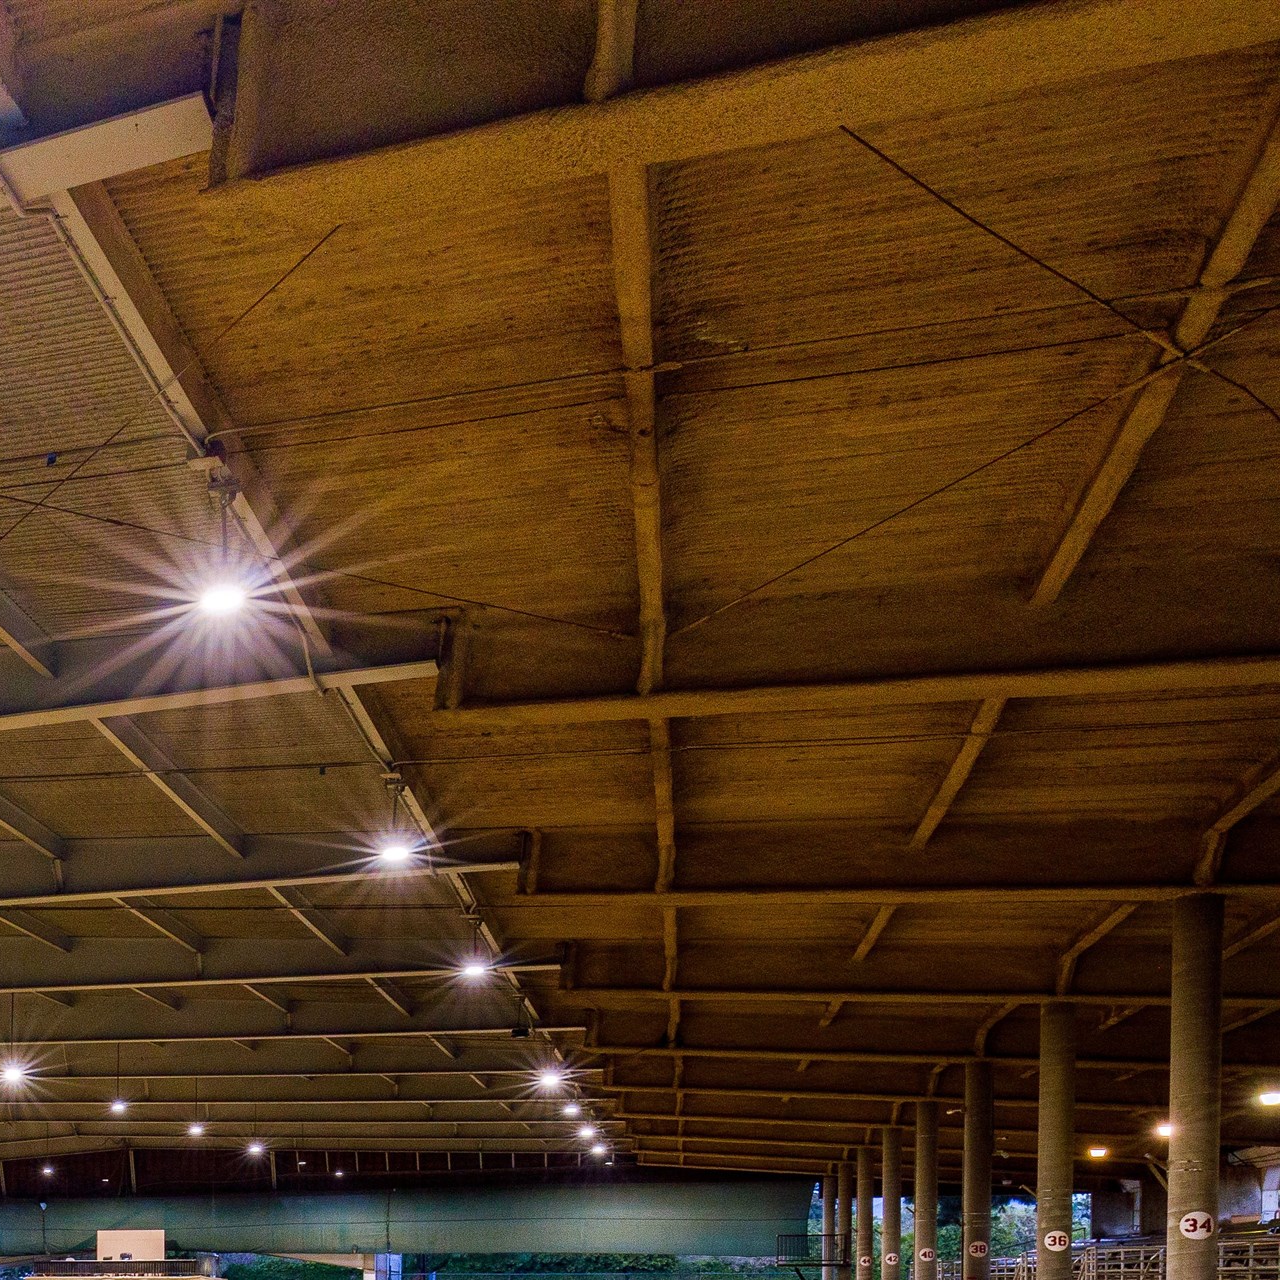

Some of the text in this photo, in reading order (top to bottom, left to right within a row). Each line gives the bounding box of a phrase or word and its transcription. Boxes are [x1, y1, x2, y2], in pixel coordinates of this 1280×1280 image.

[1183, 1217, 1212, 1233] 34
[1047, 1235, 1067, 1247] 36
[970, 1244, 987, 1254] 38
[886, 1255, 898, 1263] 42
[920, 1251, 934, 1259] 40
